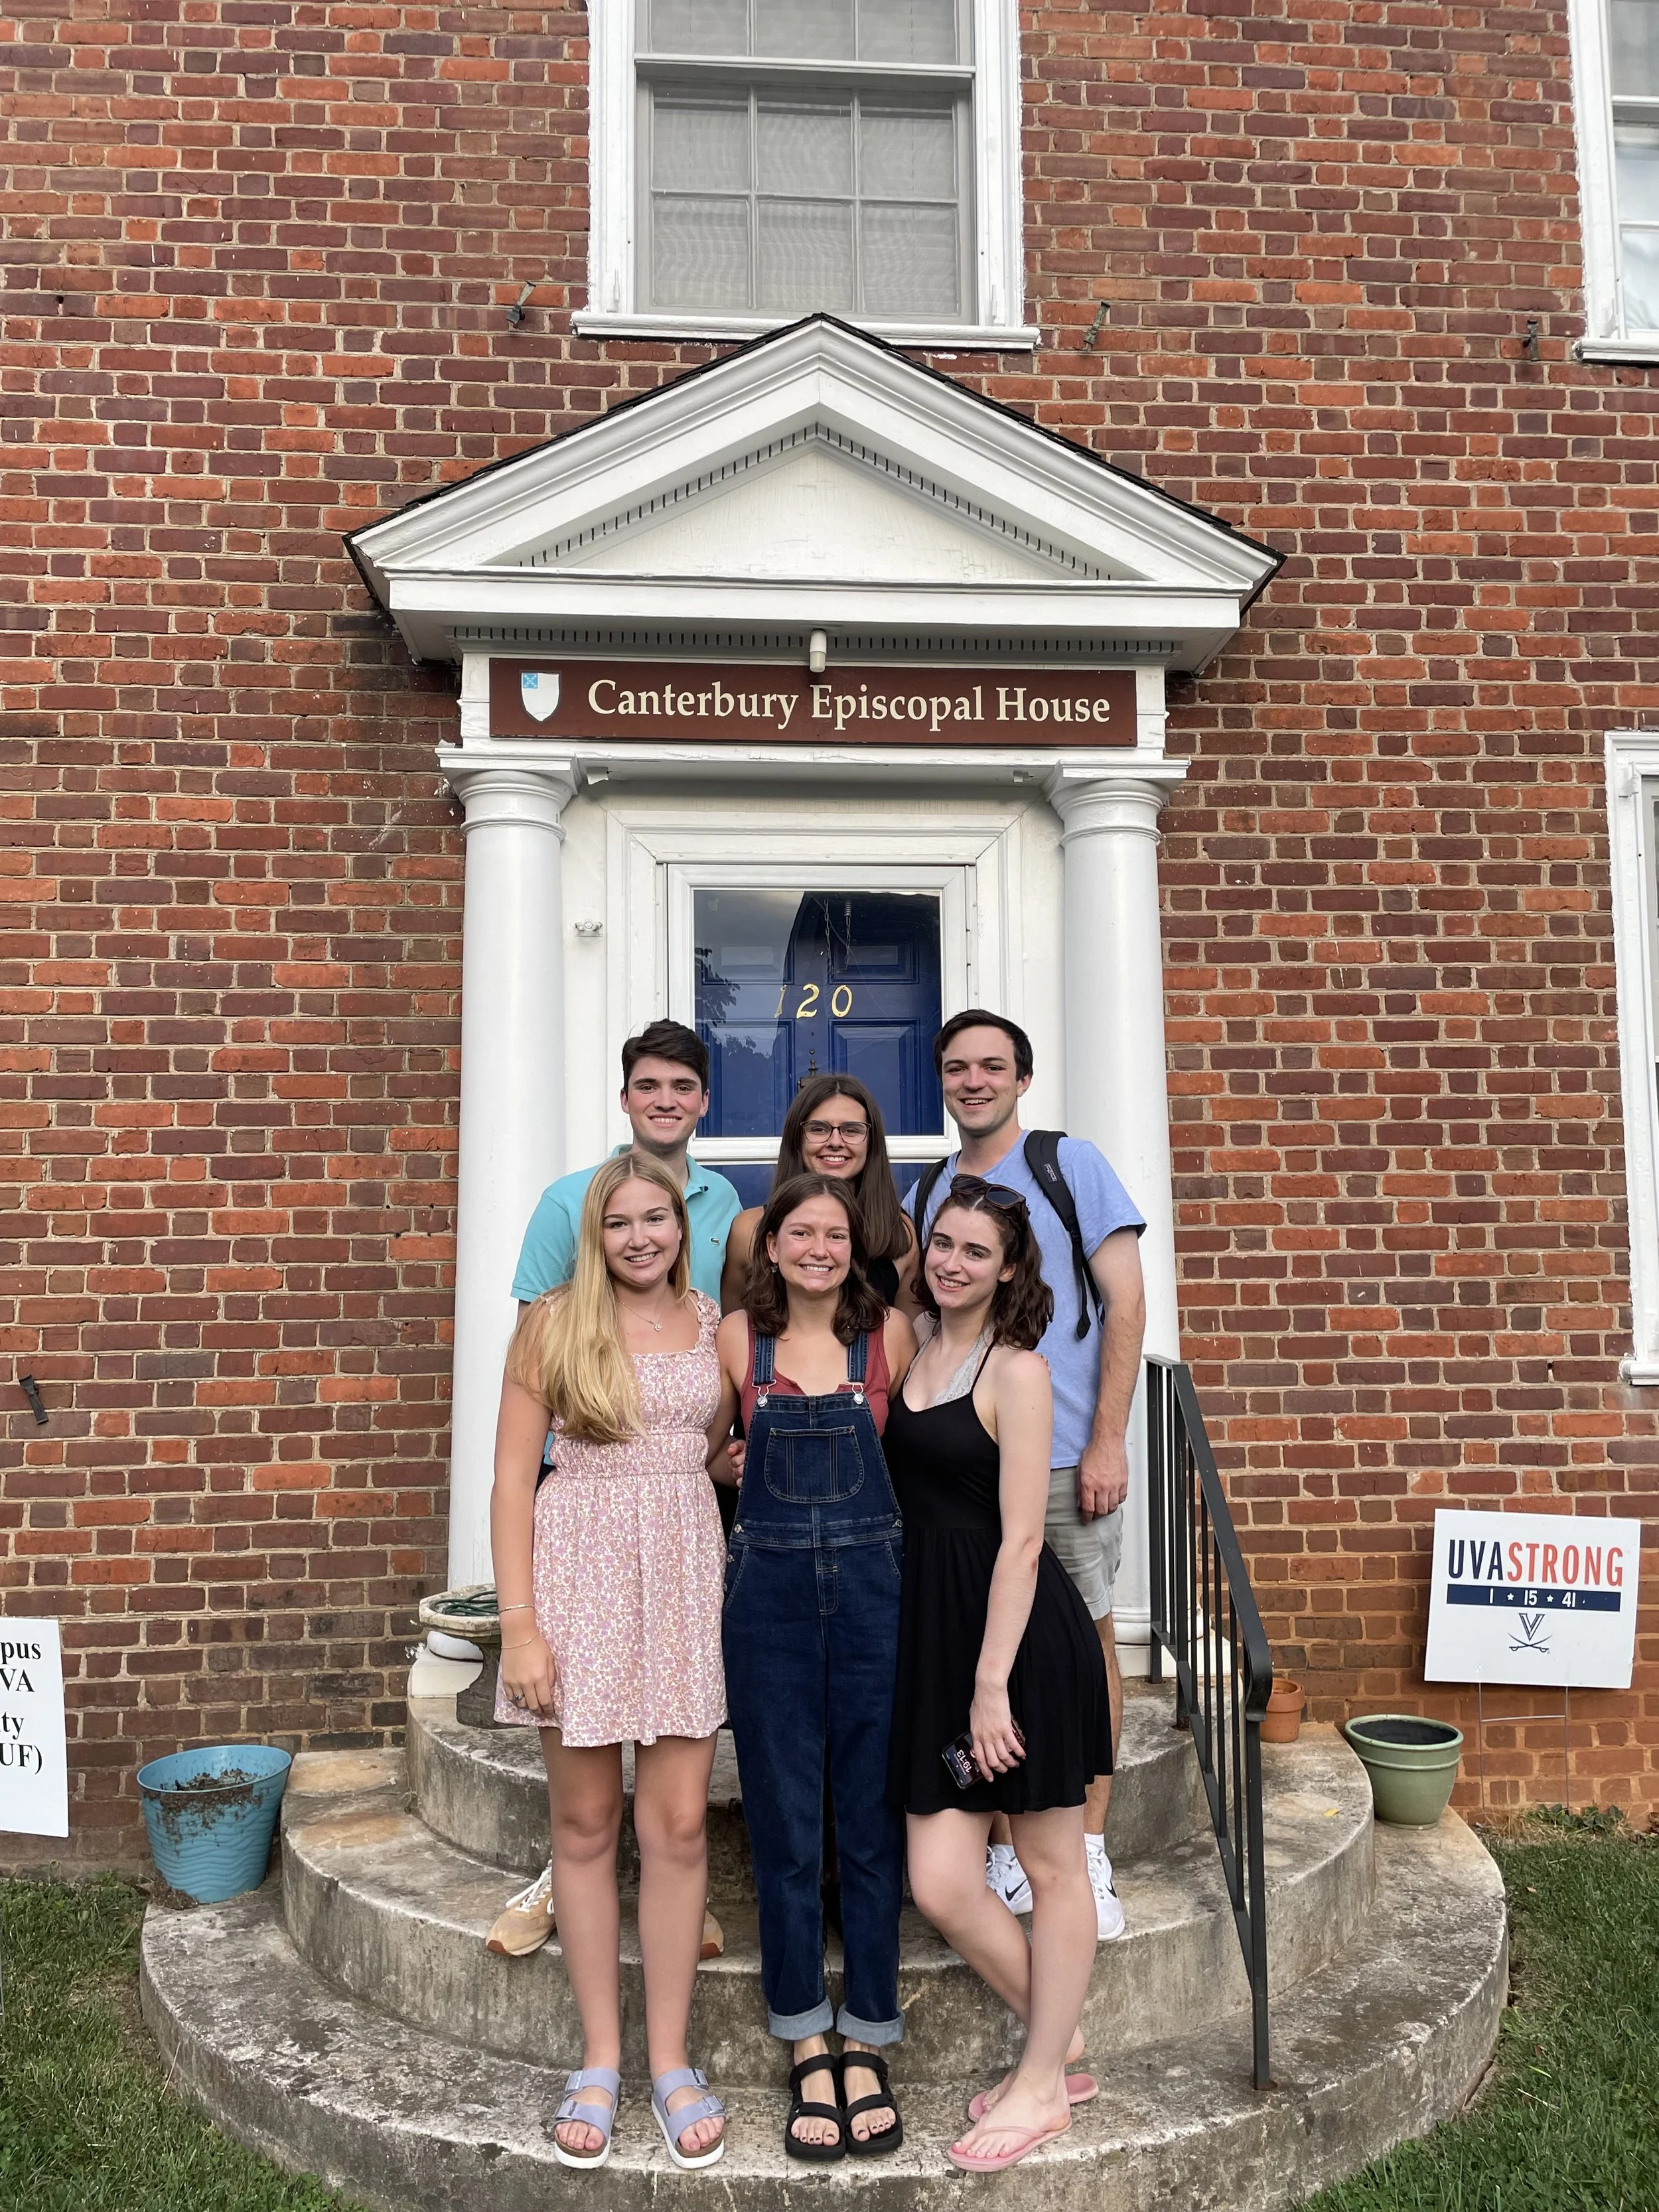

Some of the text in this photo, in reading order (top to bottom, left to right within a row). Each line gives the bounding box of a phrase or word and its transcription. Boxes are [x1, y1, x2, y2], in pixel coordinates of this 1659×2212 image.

[588, 679, 1110, 732] Canterbury Episcopal House
[774, 982, 853, 1019] 120
[1524, 1589, 1538, 1606] 15
[1561, 1591, 1576, 1607] 41
